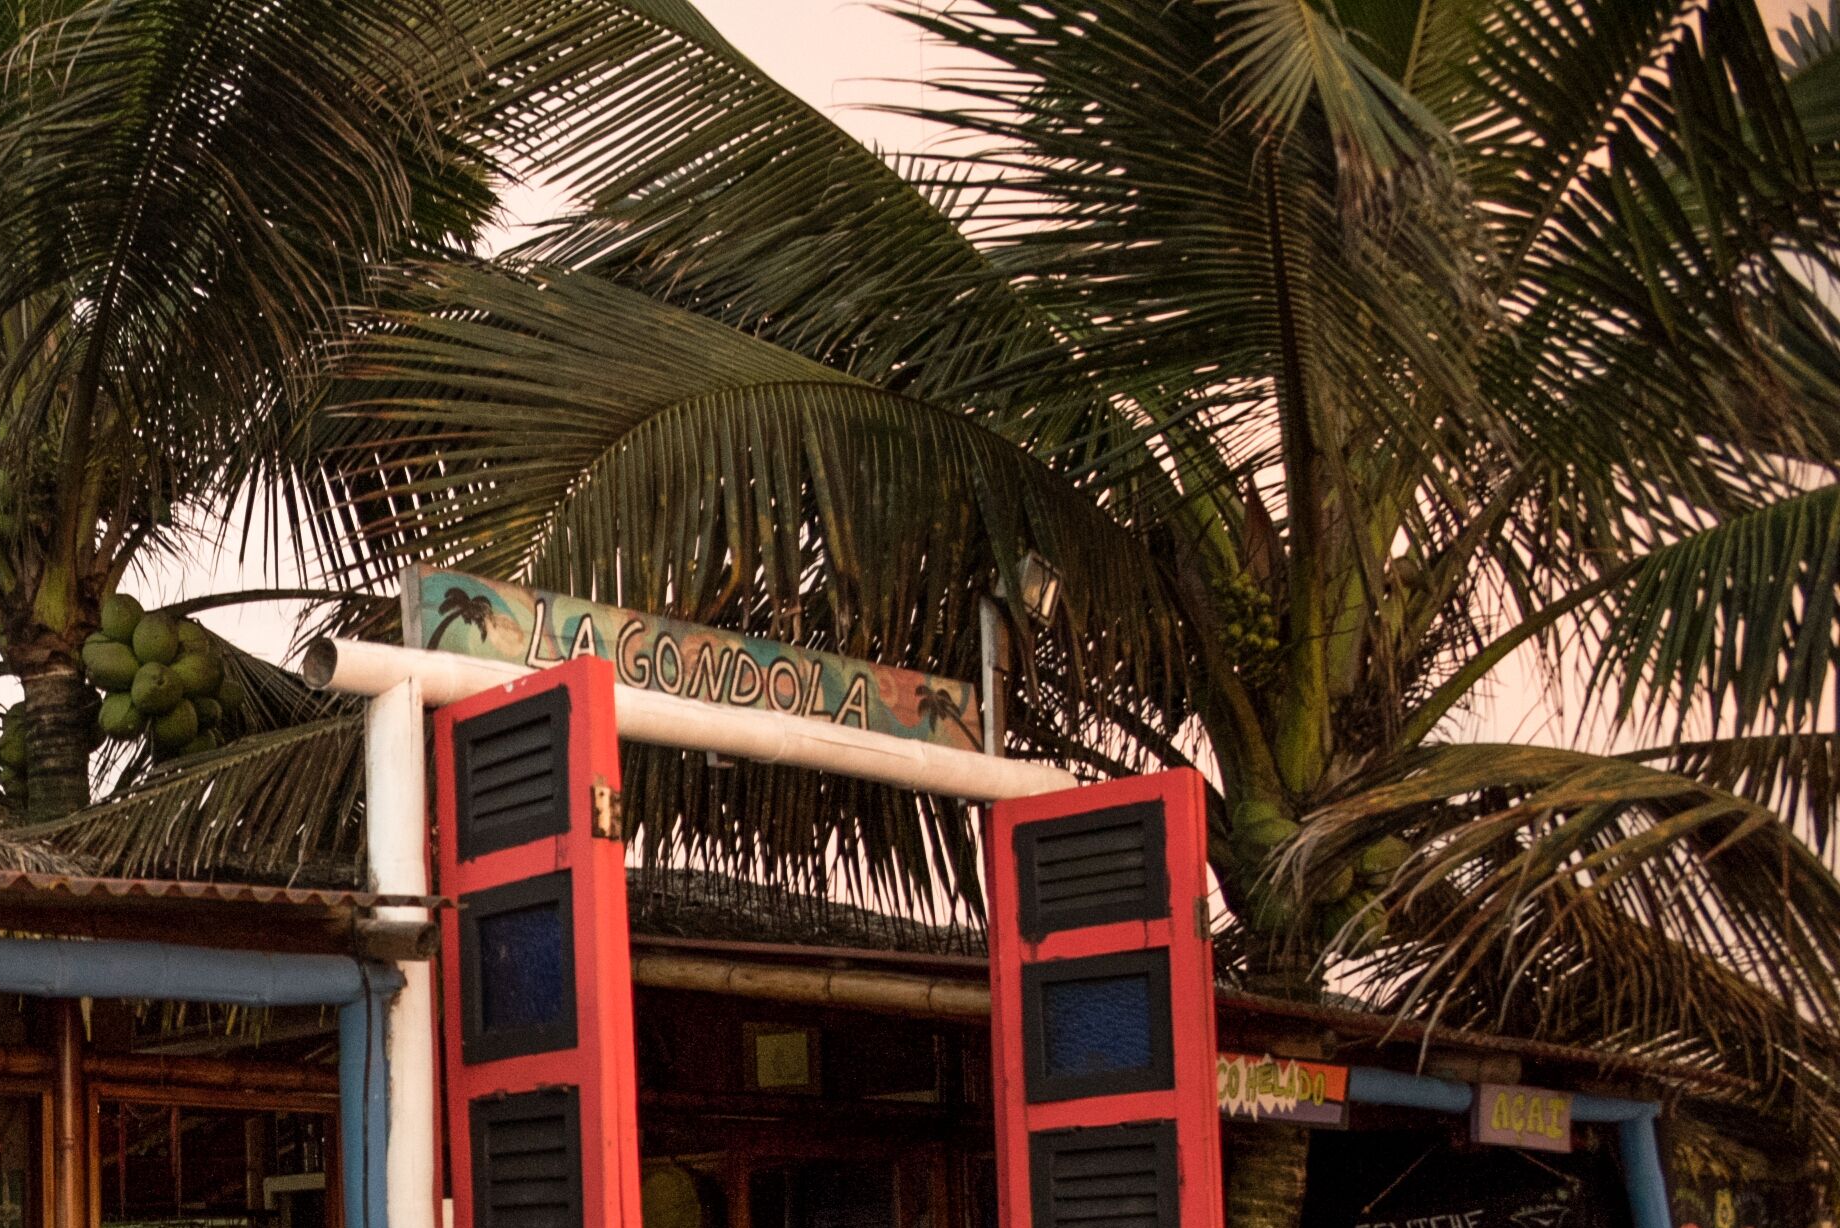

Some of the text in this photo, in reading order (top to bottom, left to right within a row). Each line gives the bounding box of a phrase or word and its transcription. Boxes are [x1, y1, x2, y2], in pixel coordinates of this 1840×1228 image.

[525, 599, 870, 731] LA GONDOLA
[1245, 1062, 1325, 1106] HELADO
